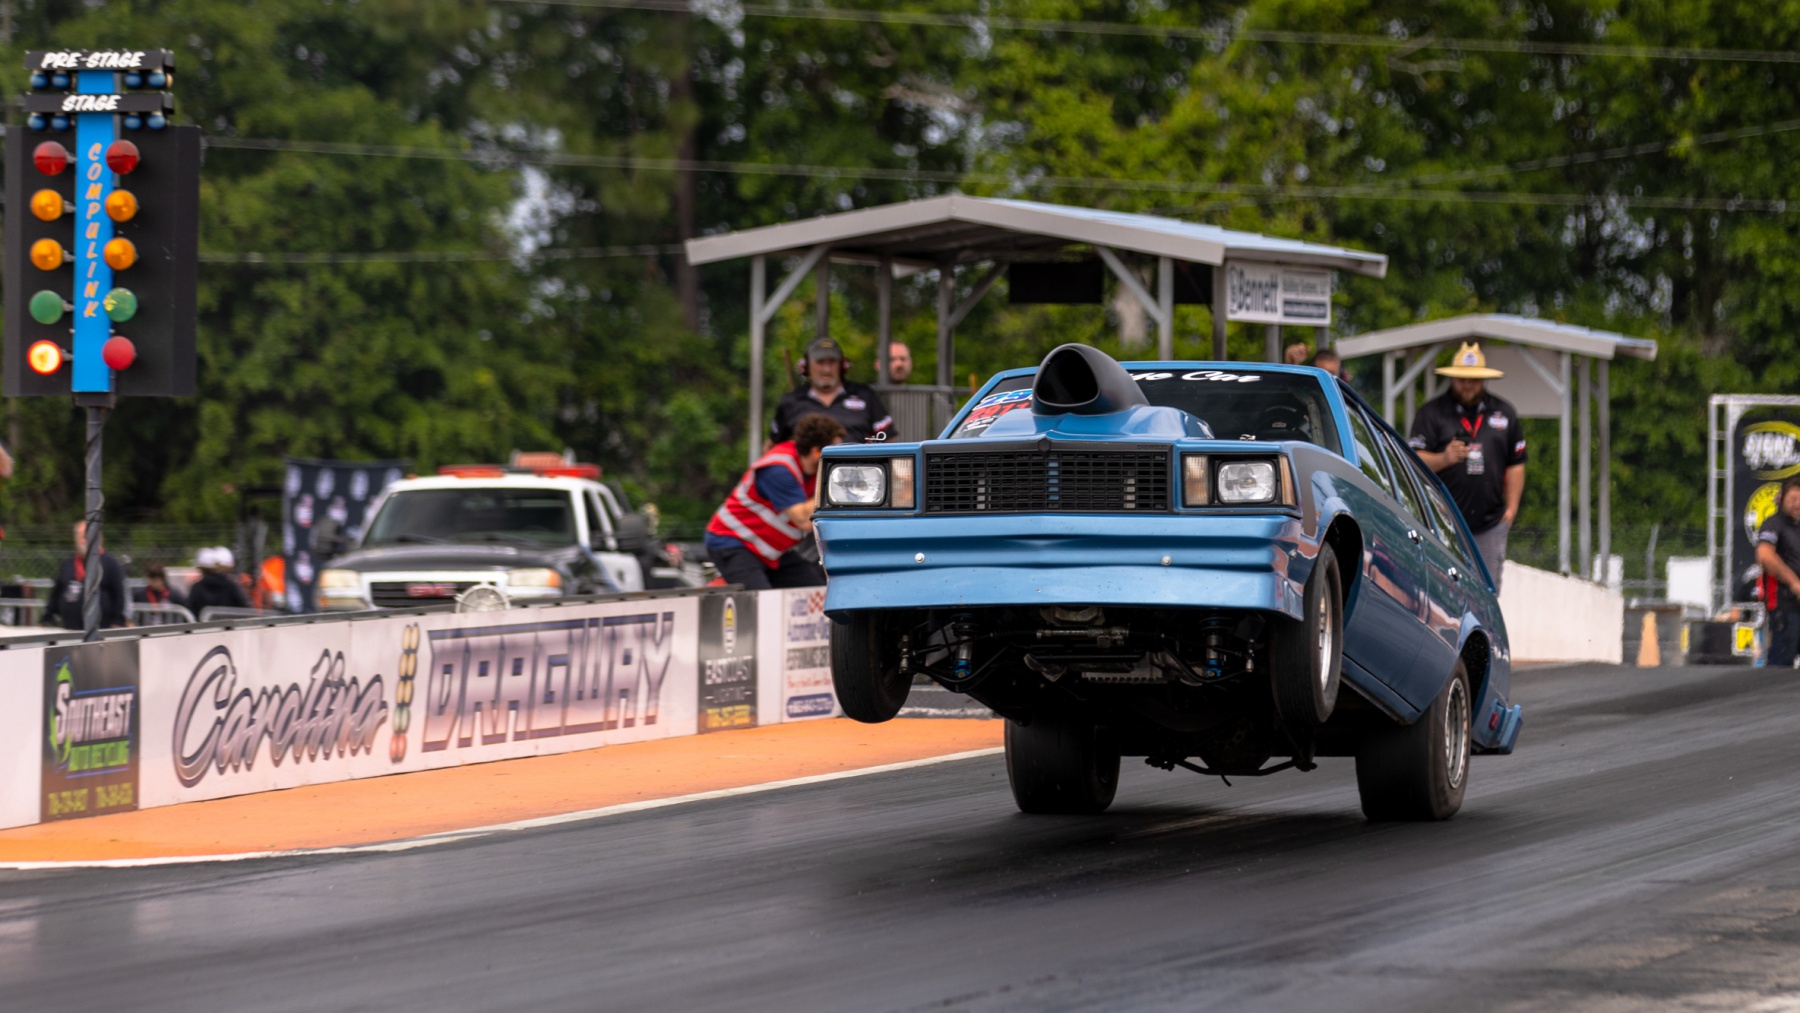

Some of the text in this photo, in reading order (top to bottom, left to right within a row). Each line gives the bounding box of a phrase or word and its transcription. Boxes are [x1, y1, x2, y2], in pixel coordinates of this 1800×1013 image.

[41, 51, 146, 69] PRE-STAGE
[61, 94, 122, 112] STAGE
[83, 142, 103, 319] COMPULINK
[171, 645, 388, 788] Carolina
[422, 611, 675, 753] DRAGWAY
